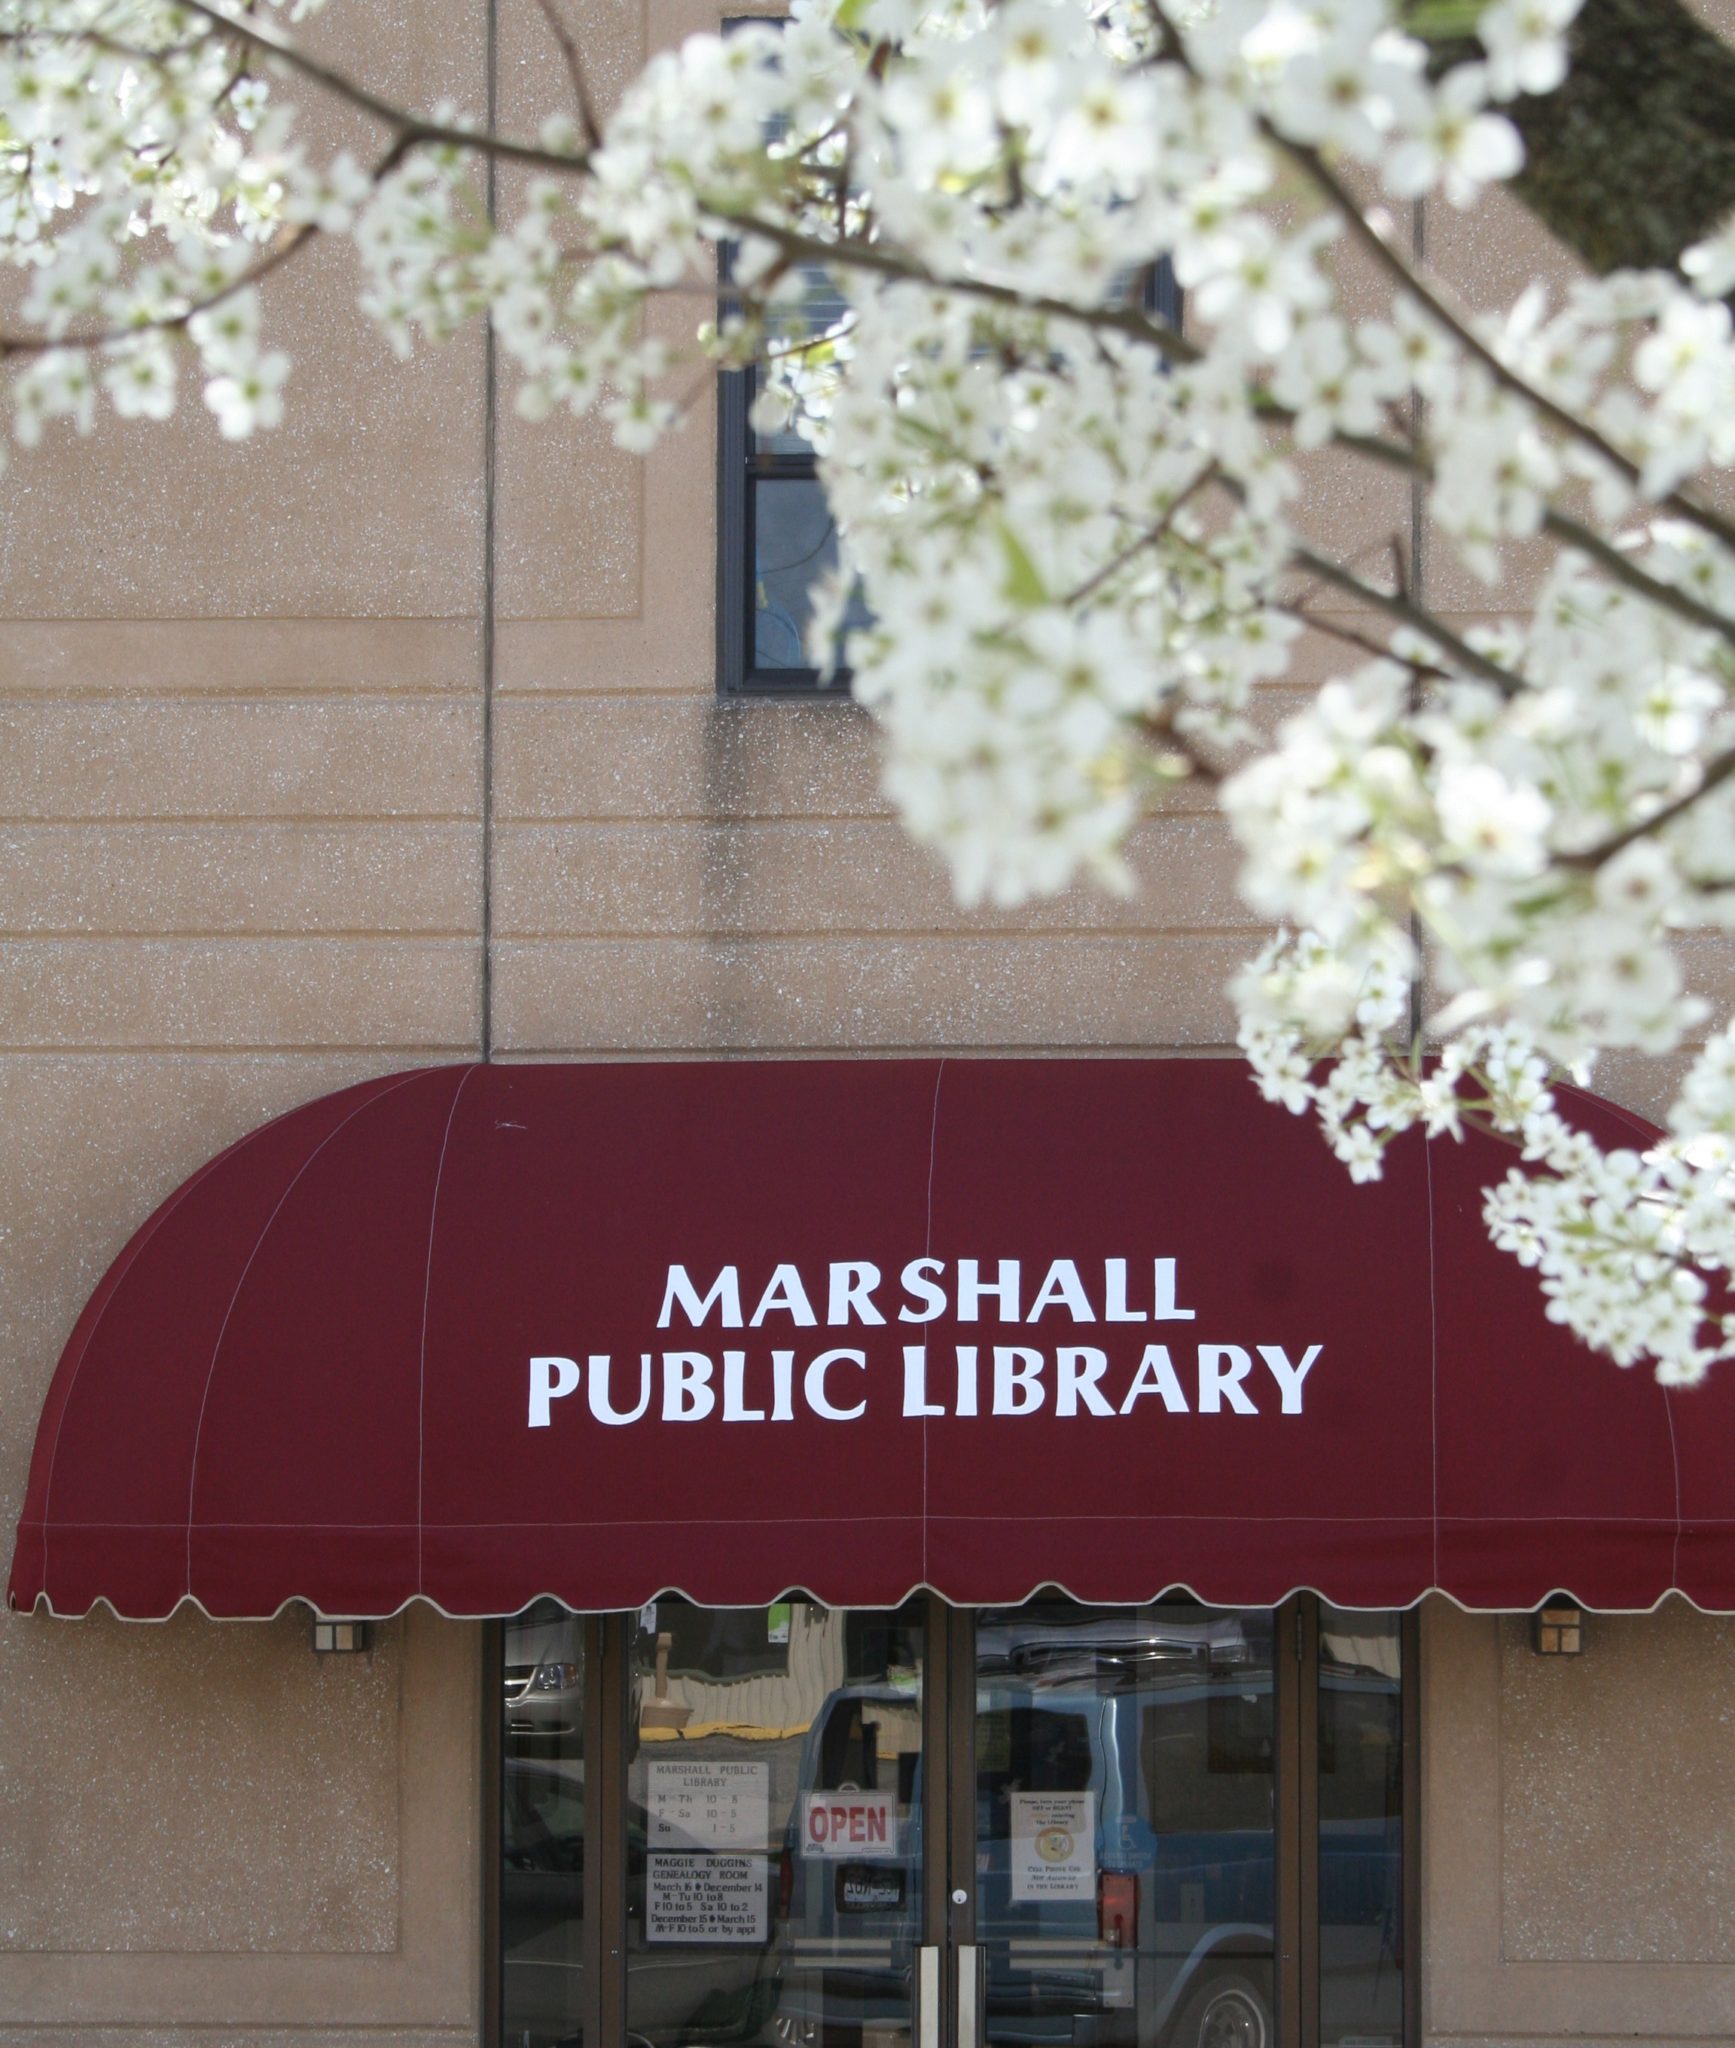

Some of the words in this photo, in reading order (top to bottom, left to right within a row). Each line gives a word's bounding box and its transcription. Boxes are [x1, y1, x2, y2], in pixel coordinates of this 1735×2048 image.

[657, 1257, 1196, 1328] MARSHALL
[528, 1349, 867, 1427] PUBLIC
[902, 1344, 1323, 1418] LIBRARY
[656, 1766, 711, 1774] MARSHALL
[720, 1766, 758, 1775] PUBLIC
[683, 1778, 727, 1786] LIBRARY
[706, 1795, 716, 1803] 10
[706, 1810, 717, 1818] 10
[658, 1824, 671, 1832] Su
[809, 1807, 886, 1842] OPEN
[655, 1859, 695, 1867] MAGGIE
[706, 1859, 752, 1867] DUGGINS
[653, 1871, 711, 1879] GENEALOGY
[720, 1871, 748, 1879] ROOM
[654, 1883, 681, 1891] March
[704, 1883, 752, 1892] December
[675, 1903, 685, 1911] to
[687, 1902, 692, 1911] 5
[700, 1902, 713, 1911] Sa
[717, 1902, 727, 1911] 10
[731, 1903, 740, 1911] to
[741, 1903, 748, 1911] 2
[651, 1914, 696, 1923] December
[699, 1915, 707, 1923] 15
[717, 1915, 745, 1923] March
[747, 1915, 755, 1923] 15
[722, 1925, 733, 1935] by
